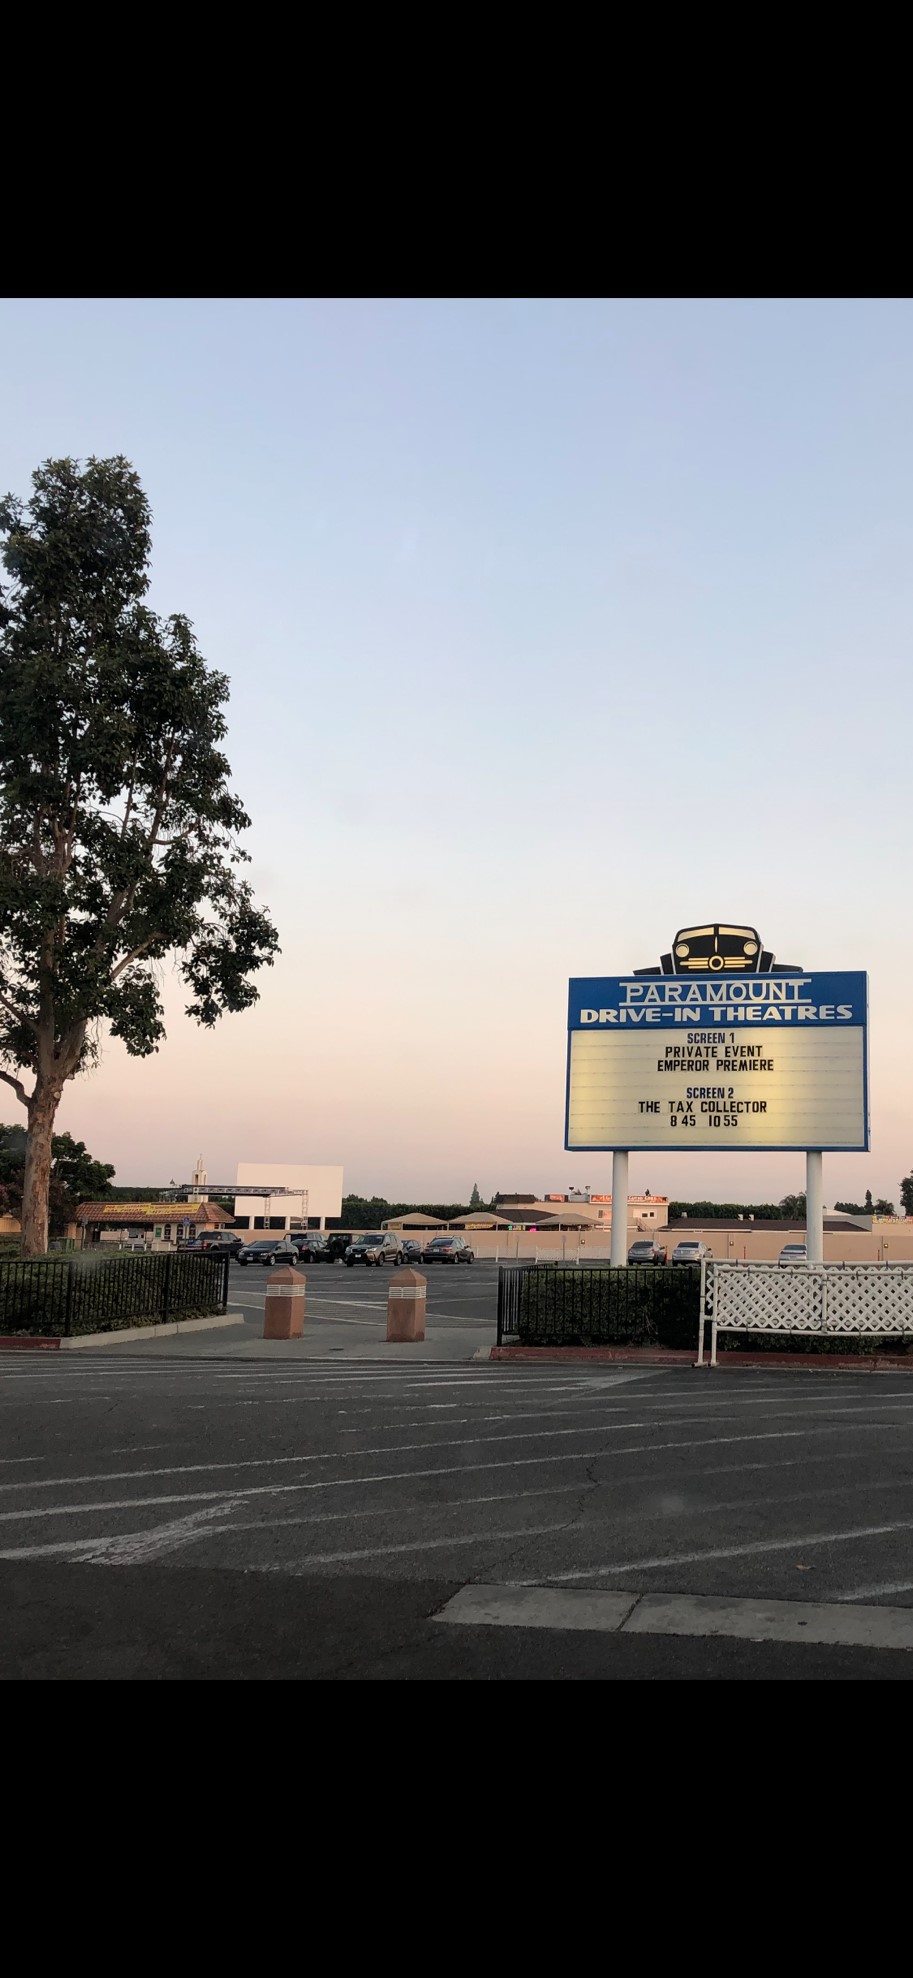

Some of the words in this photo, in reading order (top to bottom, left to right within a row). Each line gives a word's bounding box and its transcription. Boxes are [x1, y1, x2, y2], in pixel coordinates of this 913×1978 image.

[625, 980, 805, 1004] PARAMOUNT
[580, 1007, 700, 1024] DRIVE-IN
[709, 1004, 853, 1022] THEATRES
[687, 1032, 725, 1044] SCREEN
[729, 1032, 735, 1044] 1
[665, 1046, 718, 1058] PRIVATE
[724, 1045, 763, 1057] EVENT
[657, 1059, 710, 1072] EMPEROR
[716, 1059, 774, 1071] PREMIERE
[686, 1087, 725, 1099] SCREEN
[727, 1087, 734, 1099] 2
[638, 1101, 661, 1113] THE
[668, 1101, 694, 1113] TAX
[700, 1101, 767, 1113] COLLECTOR
